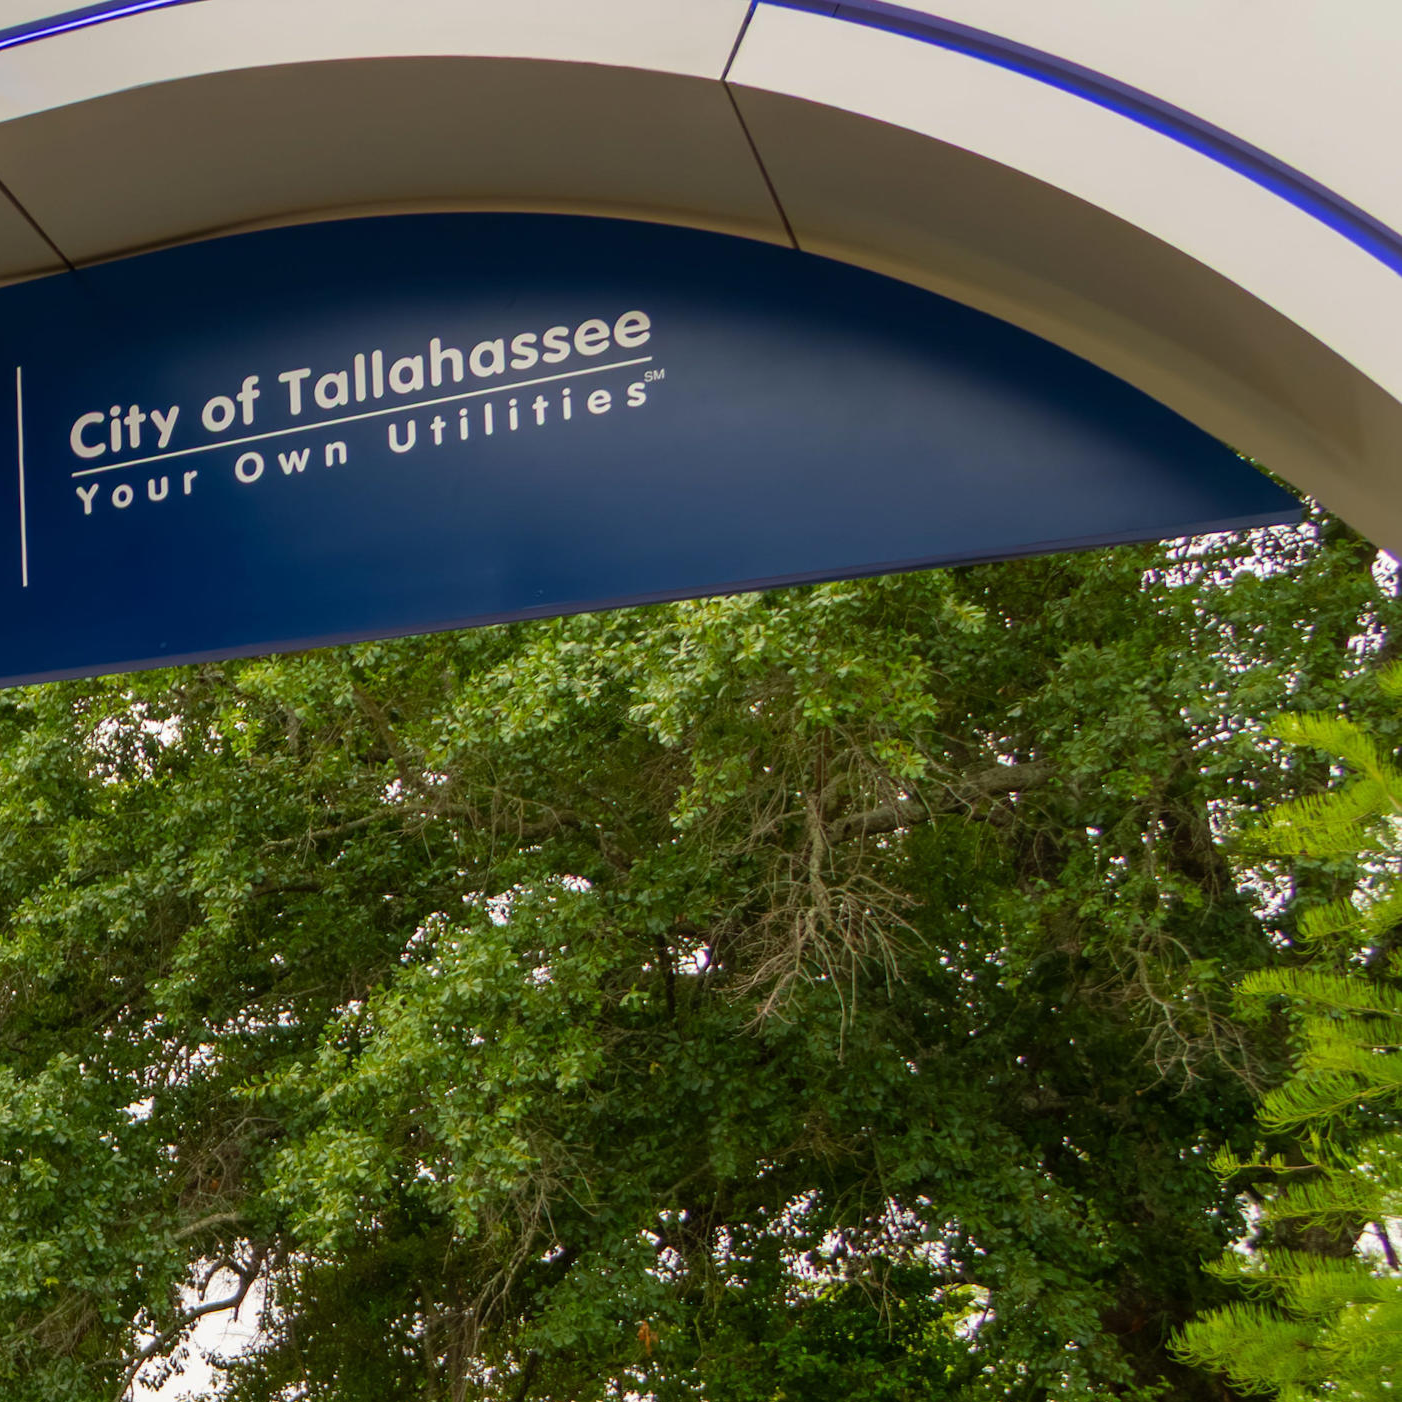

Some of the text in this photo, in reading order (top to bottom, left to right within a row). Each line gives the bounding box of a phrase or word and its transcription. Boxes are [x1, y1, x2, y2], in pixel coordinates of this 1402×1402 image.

[70, 310, 652, 458] City of Tallahassee
[76, 470, 198, 515] Your
[234, 441, 348, 484] Own
[388, 381, 648, 454] Utilities
